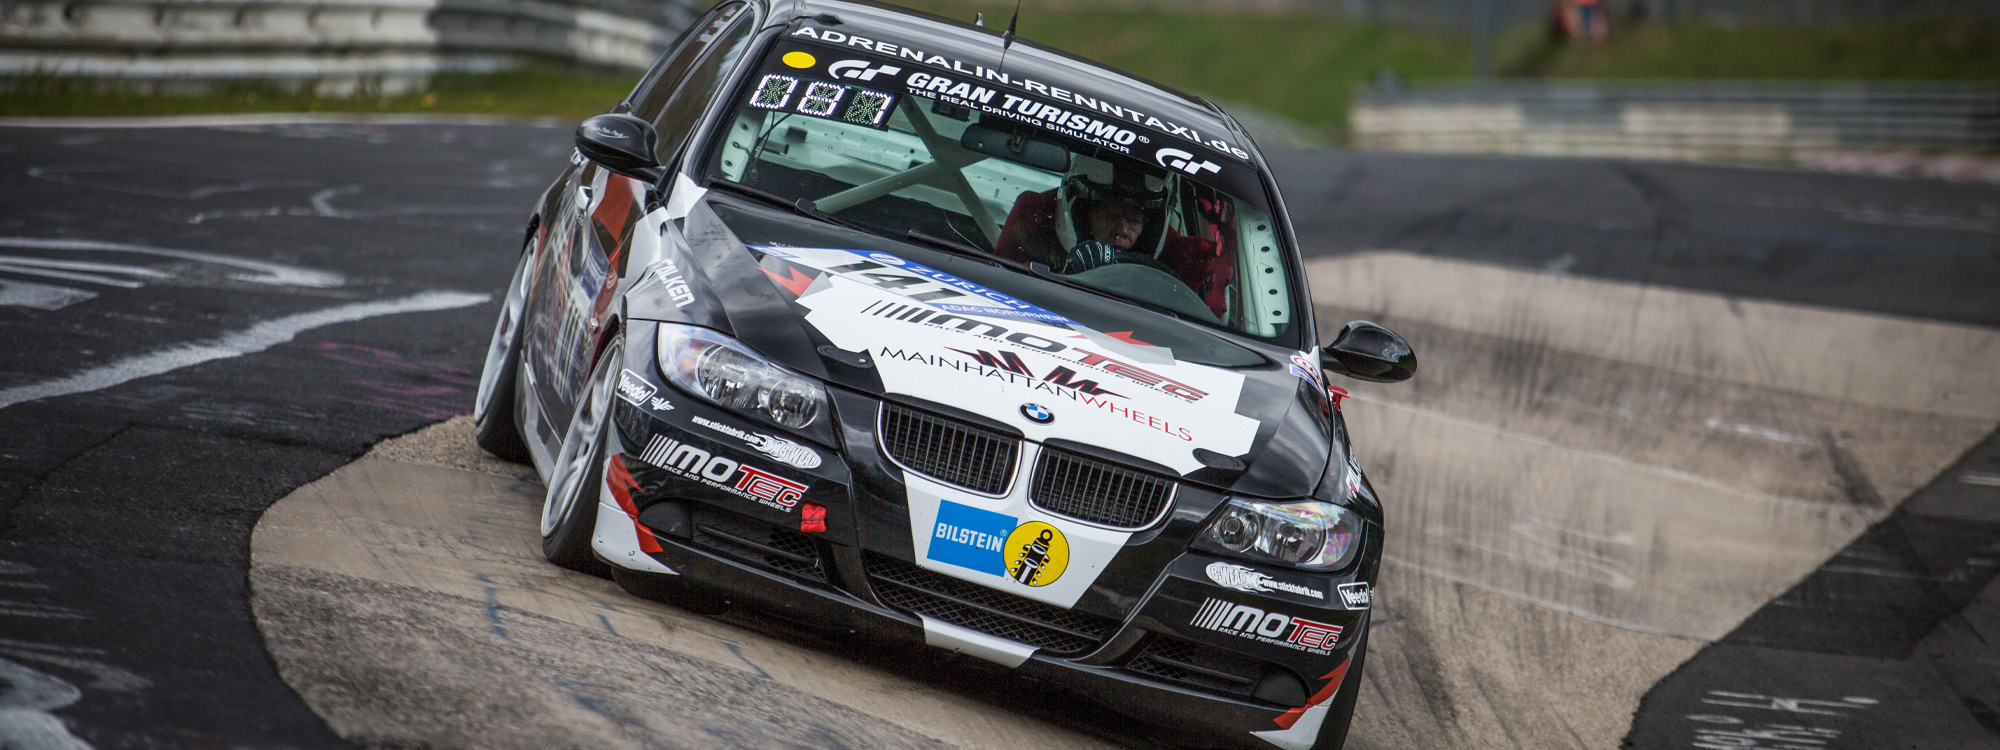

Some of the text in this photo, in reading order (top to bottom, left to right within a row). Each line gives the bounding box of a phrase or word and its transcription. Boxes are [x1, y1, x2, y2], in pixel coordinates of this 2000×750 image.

[793, 26, 1249, 160] ADRENALIN-RENNTAXI.de
[906, 72, 1137, 146] GRAN TURISMO
[907, 87, 1130, 154] THE REAL DRIVING SIMULATOR
[652, 258, 695, 308] FALKEN
[826, 260, 967, 302] 141
[906, 265, 1031, 310] ZURICH
[941, 304, 1069, 323] ADAC NORDRHEIN
[924, 323, 965, 334] RACE
[1010, 343, 1124, 379] PERFORMANCE
[1132, 380, 1194, 404] WHEELS
[618, 373, 652, 402] Veedol
[662, 464, 793, 513] RACE AND PERFORMANCE WHEELS
[935, 522, 1004, 552] BILSTEIN
[1217, 627, 1332, 656] RACE AND PERFORMANCE WHEELS
